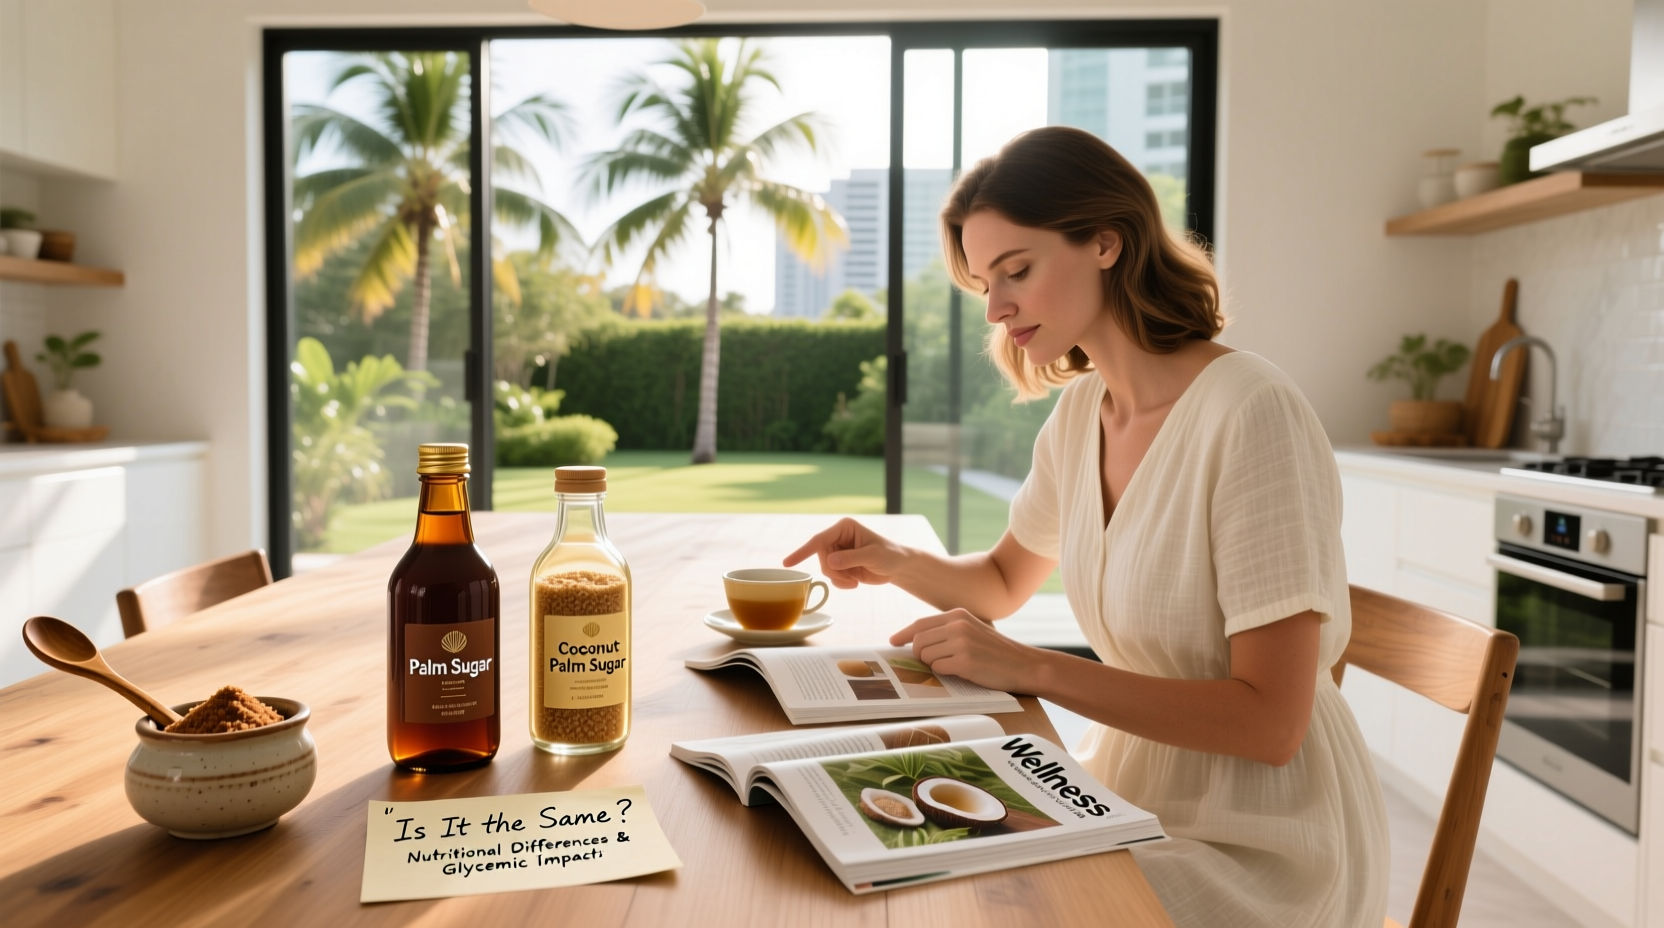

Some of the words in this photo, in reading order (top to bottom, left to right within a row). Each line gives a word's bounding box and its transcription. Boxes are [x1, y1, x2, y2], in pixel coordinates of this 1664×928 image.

[558, 640, 620, 655] Coconut
[409, 658, 448, 675] Palm
[450, 658, 493, 678] Sugar
[549, 658, 586, 673] Palm
[589, 657, 626, 675] Sugar
[1001, 737, 1111, 817] Wellness
[440, 816, 471, 838] It
[481, 812, 526, 834] the
[408, 843, 501, 863] Nutritional
[511, 837, 608, 854] Differences
[616, 831, 630, 843] &
[442, 857, 528, 877] Glycemic
